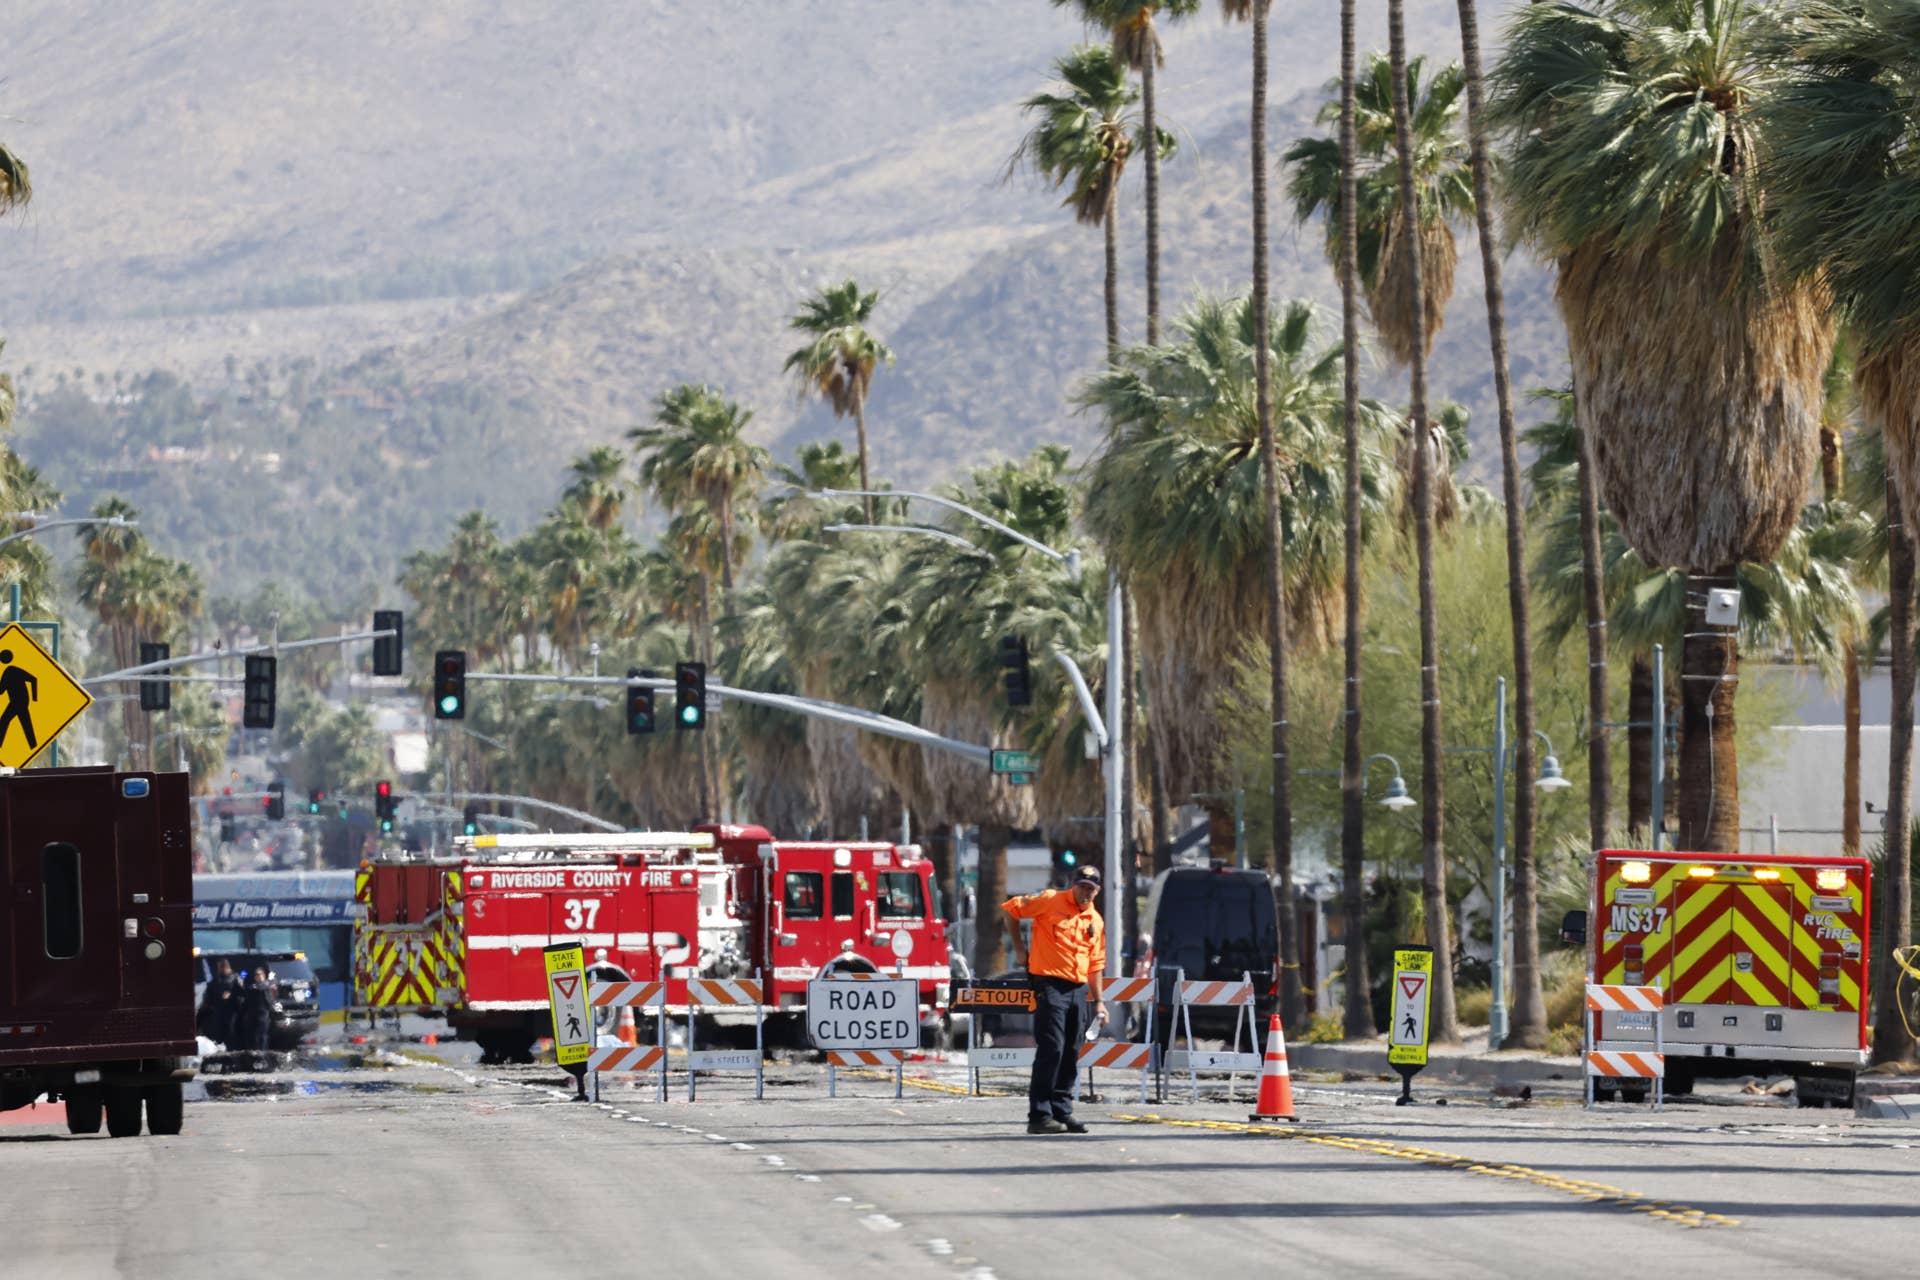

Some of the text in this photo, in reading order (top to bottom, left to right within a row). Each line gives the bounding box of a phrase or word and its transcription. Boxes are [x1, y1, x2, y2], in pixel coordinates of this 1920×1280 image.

[491, 871, 672, 889] RIVERSIDE COUNTY FIRE
[231, 902, 269, 918] Clean
[270, 902, 332, 917] Tomorrow
[564, 899, 601, 930] 37
[1610, 905, 1668, 934] MS37
[1803, 913, 1835, 926] RVC
[1815, 927, 1853, 940] FIRE
[394, 940, 423, 977] 37
[552, 952, 575, 961] STATE
[556, 961, 573, 969] LAW
[829, 990, 896, 1010] ROAD
[961, 990, 1032, 1003] DETOUR
[818, 1020, 909, 1040] CLOSED
